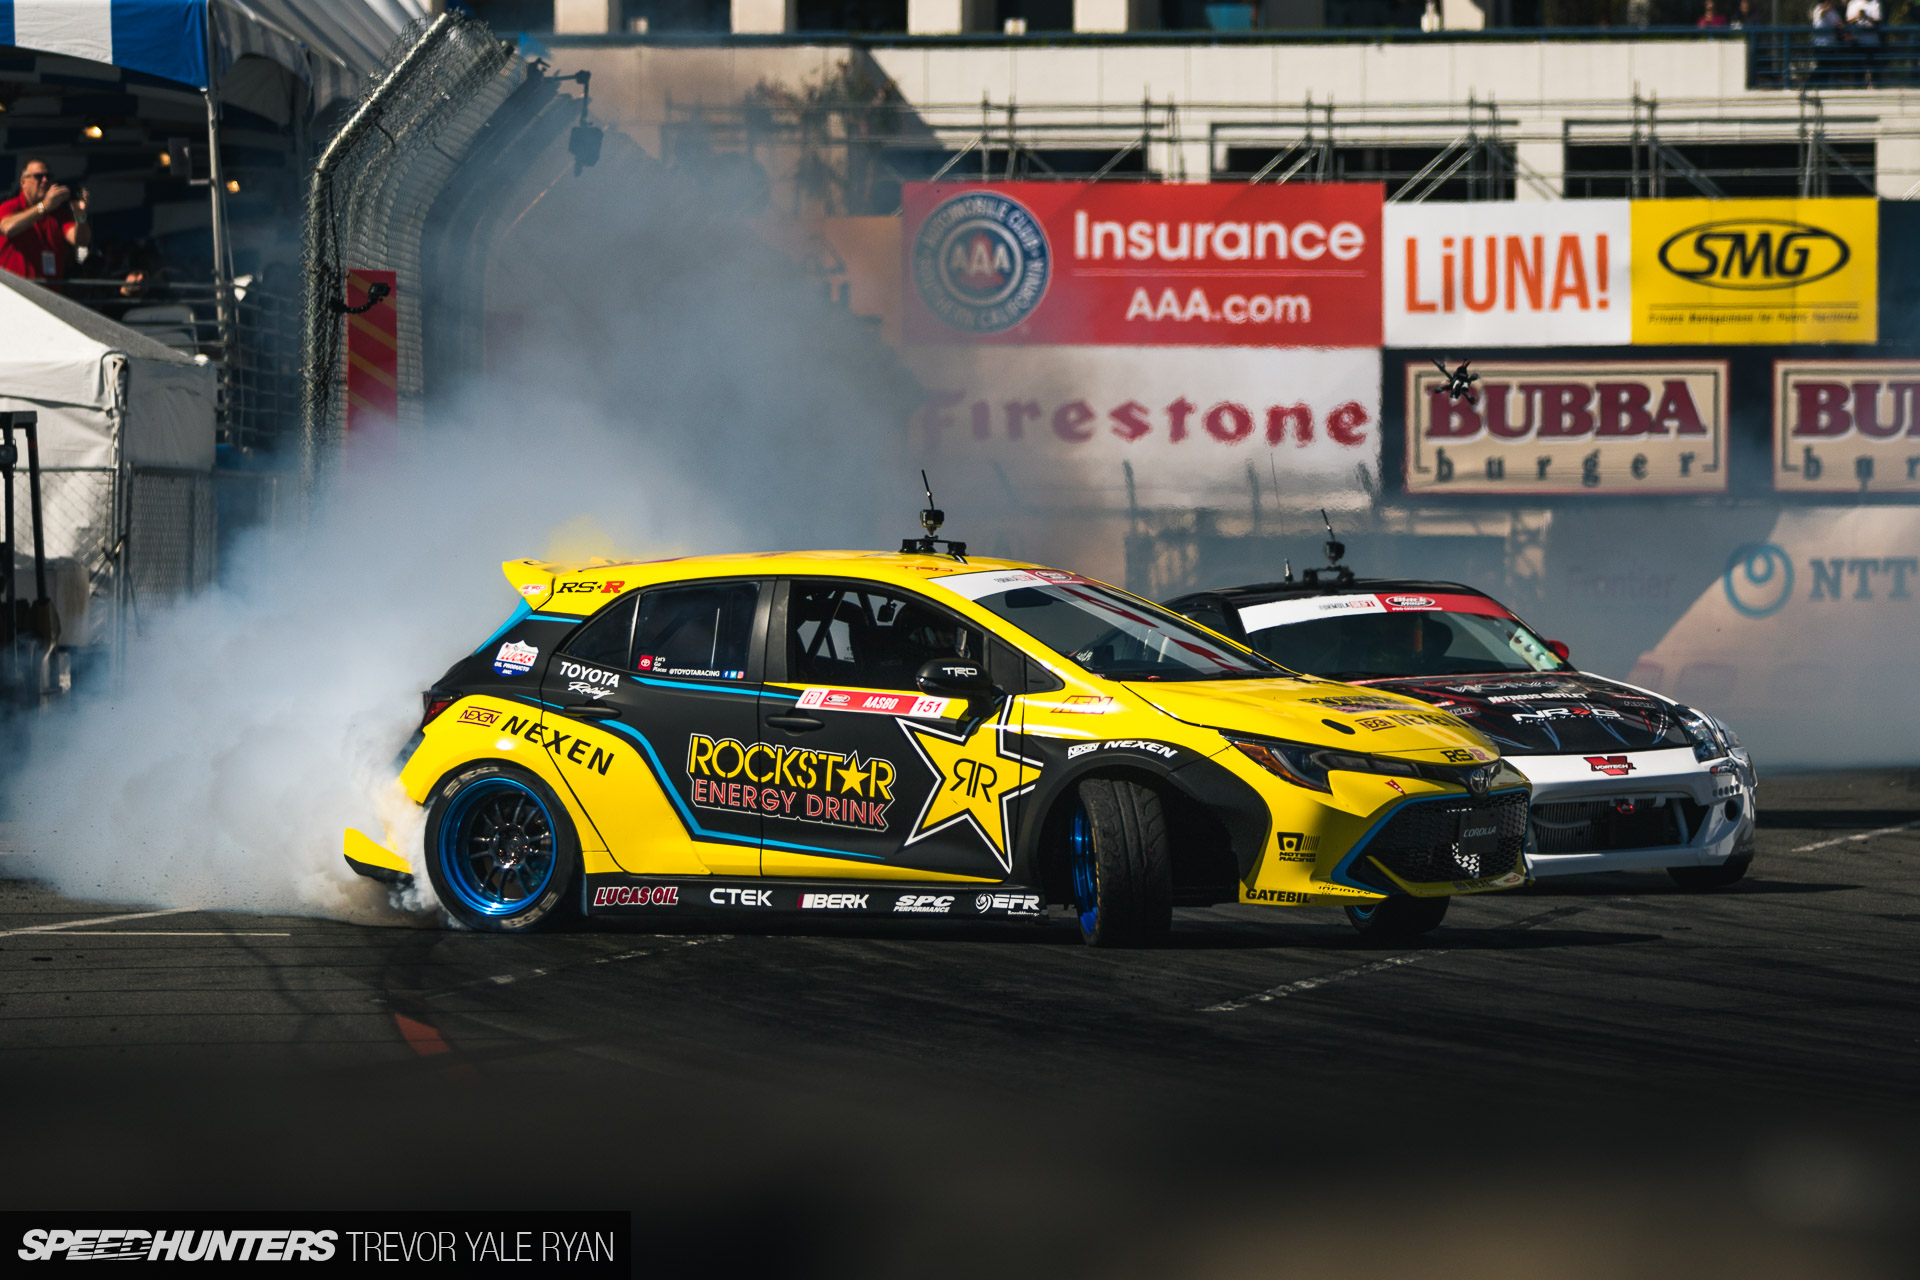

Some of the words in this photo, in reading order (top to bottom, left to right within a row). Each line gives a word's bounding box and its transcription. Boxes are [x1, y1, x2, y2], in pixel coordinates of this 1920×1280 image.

[1074, 211, 1366, 260] Insurance
[950, 241, 1012, 278] AAA
[1691, 231, 1812, 280] SMG
[1405, 234, 1609, 314] LiUNA!
[1126, 287, 1311, 324] AAA.com
[1425, 380, 1708, 440] BUBBA
[1792, 381, 1920, 440] BU
[921, 389, 1372, 451] Firestone
[1436, 447, 1696, 487] burger
[1809, 556, 1920, 601] NTT
[499, 650, 536, 665] LUCAS
[559, 661, 620, 688] TOYOTA
[669, 668, 720, 677] @TOYOTARACING
[942, 667, 978, 678] TRD
[806, 691, 820, 705] FD
[862, 695, 900, 711] AASBO
[916, 700, 943, 714] 151
[1488, 692, 1542, 704] NITROUS
[500, 715, 615, 777] NEXEN
[1104, 740, 1179, 759] NEXEN
[694, 778, 797, 814] ENERGY
[806, 794, 886, 827] DRINK
[1463, 826, 1497, 838] COROLLA
[593, 886, 651, 906] LUCAS
[651, 886, 679, 906] OIL
[709, 888, 773, 907] CTEK
[811, 893, 870, 909] BERK
[895, 895, 956, 907] SPC
[992, 893, 1040, 910] EFR
[1245, 888, 1311, 903] GATEBIL
